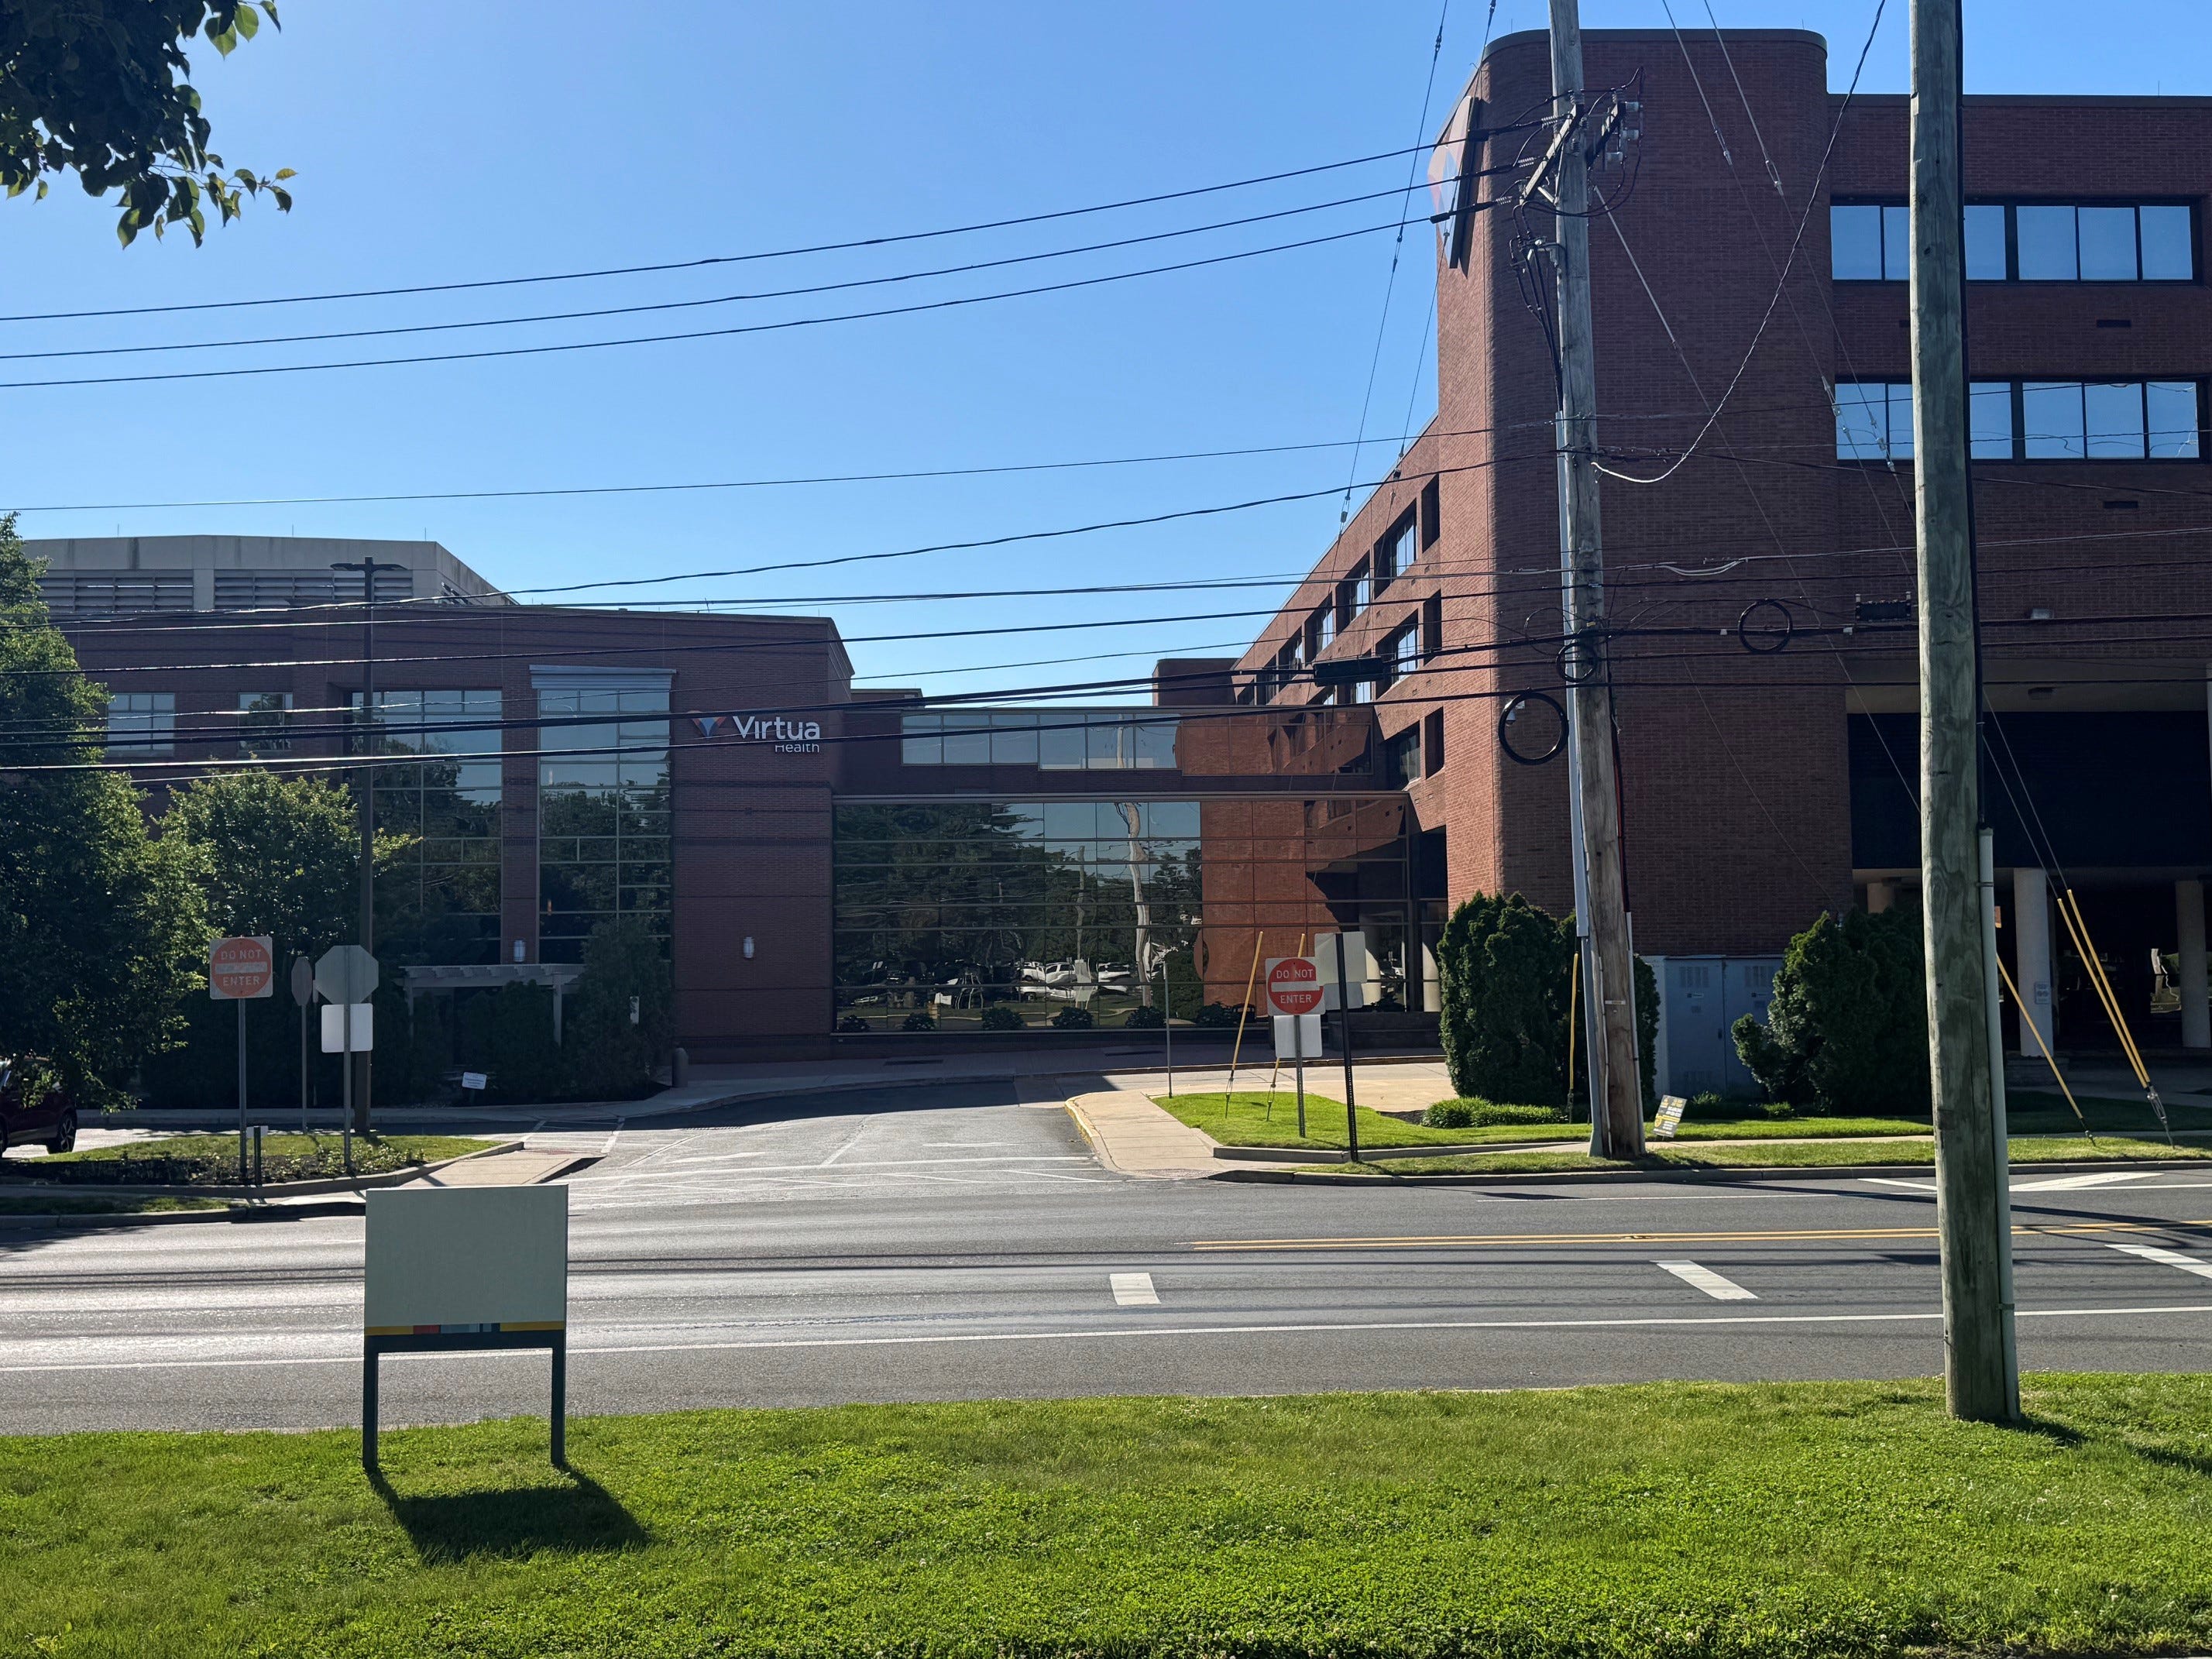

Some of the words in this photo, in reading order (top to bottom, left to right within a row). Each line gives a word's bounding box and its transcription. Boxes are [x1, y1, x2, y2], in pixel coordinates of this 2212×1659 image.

[732, 715, 820, 740] Virtua
[775, 741, 820, 753] Health
[221, 950, 236, 960] DO
[239, 949, 262, 960] NOT
[1276, 970, 1290, 979] DO
[1294, 969, 1314, 978] NOT
[222, 976, 260, 986] ENTER
[1280, 994, 1312, 1004] ENTER
